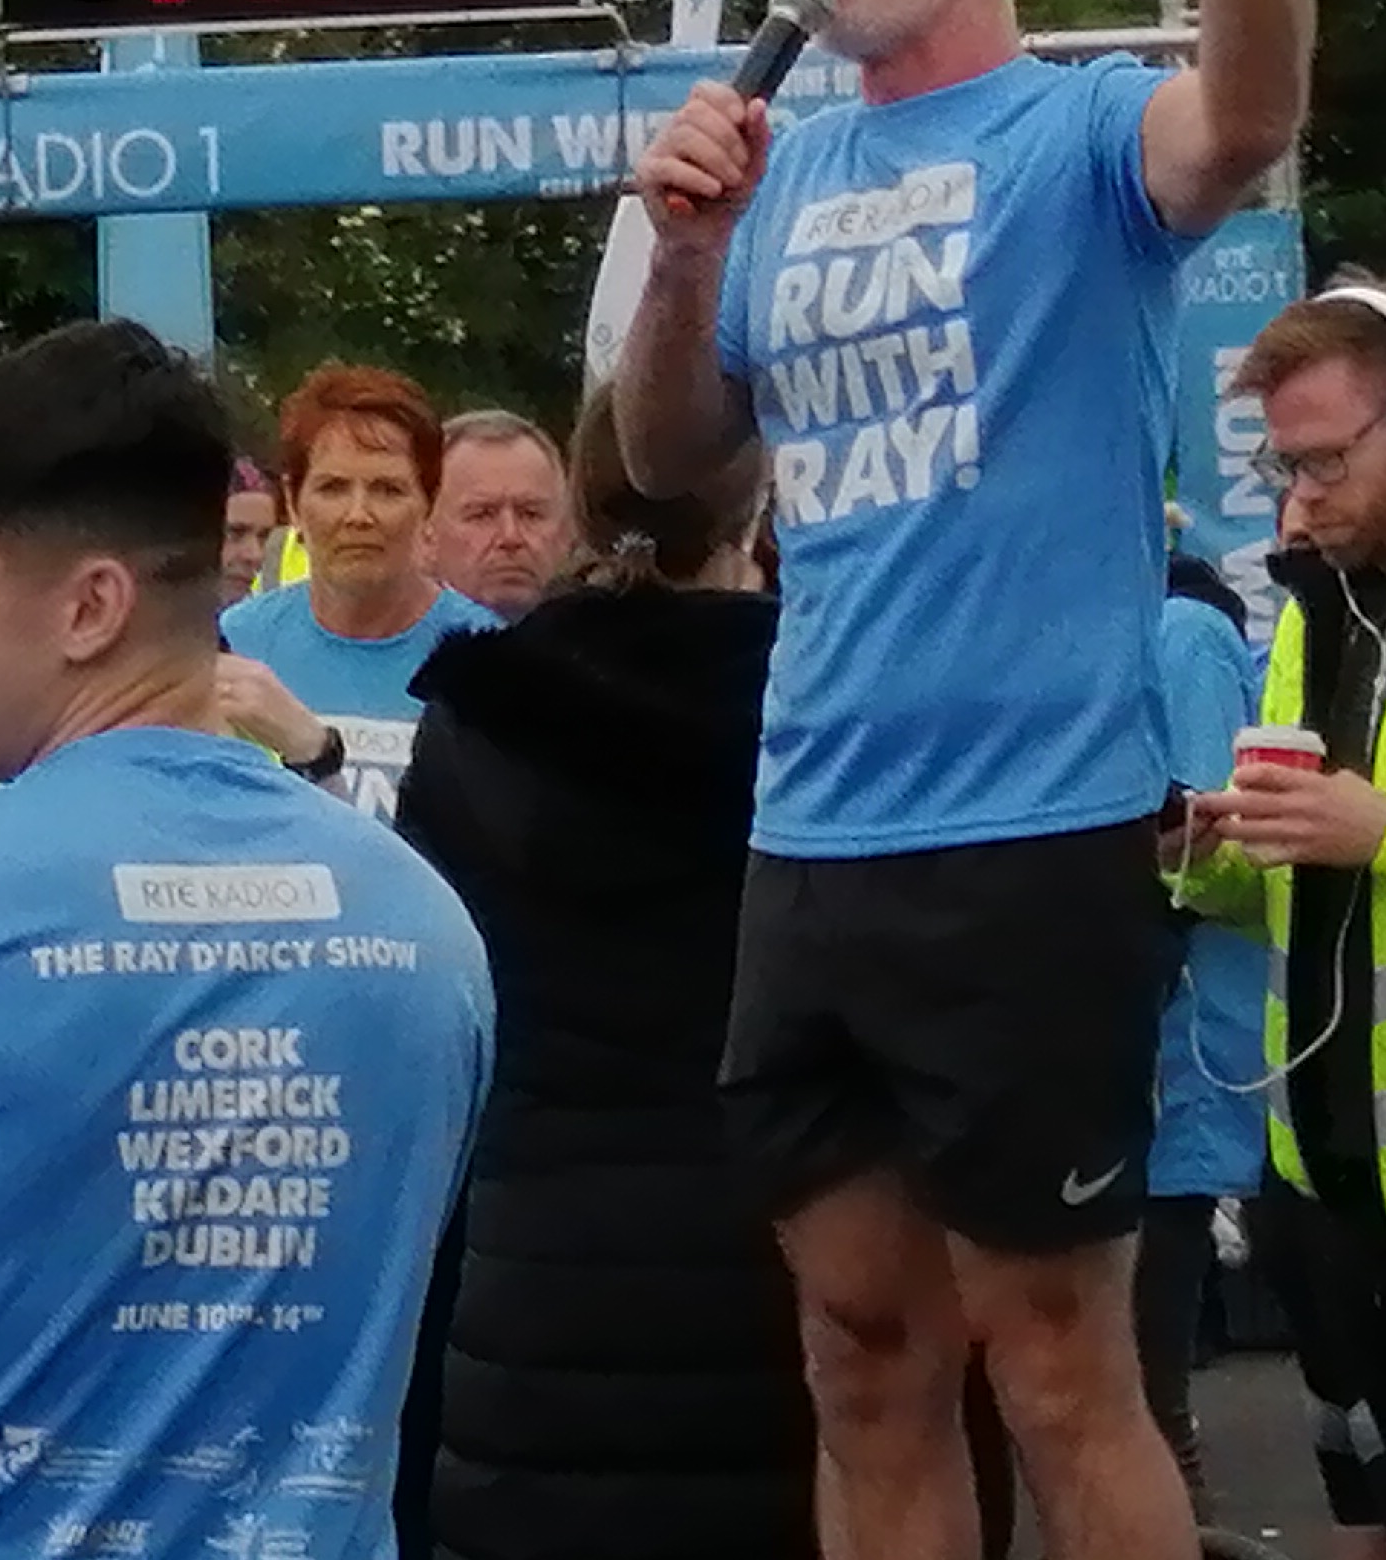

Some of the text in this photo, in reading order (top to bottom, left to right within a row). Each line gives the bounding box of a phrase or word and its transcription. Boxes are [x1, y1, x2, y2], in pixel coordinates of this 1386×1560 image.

[198, 125, 219, 196] 1
[381, 114, 533, 177] RUN
[768, 231, 971, 353] RUN
[770, 319, 977, 434] WITH
[774, 403, 981, 528] RAY!
[203, 879, 300, 909] RADIO
[305, 877, 317, 907] 1
[30, 935, 417, 979] THE RAY D'ARCY SHOW
[174, 1026, 307, 1072] CORK
[129, 1073, 343, 1122] LIMERICK
[116, 1125, 351, 1172] WEXFORD
[133, 1175, 332, 1223] KILDARE
[141, 1224, 317, 1269] DUBLIN
[112, 1301, 190, 1333] JUNE
